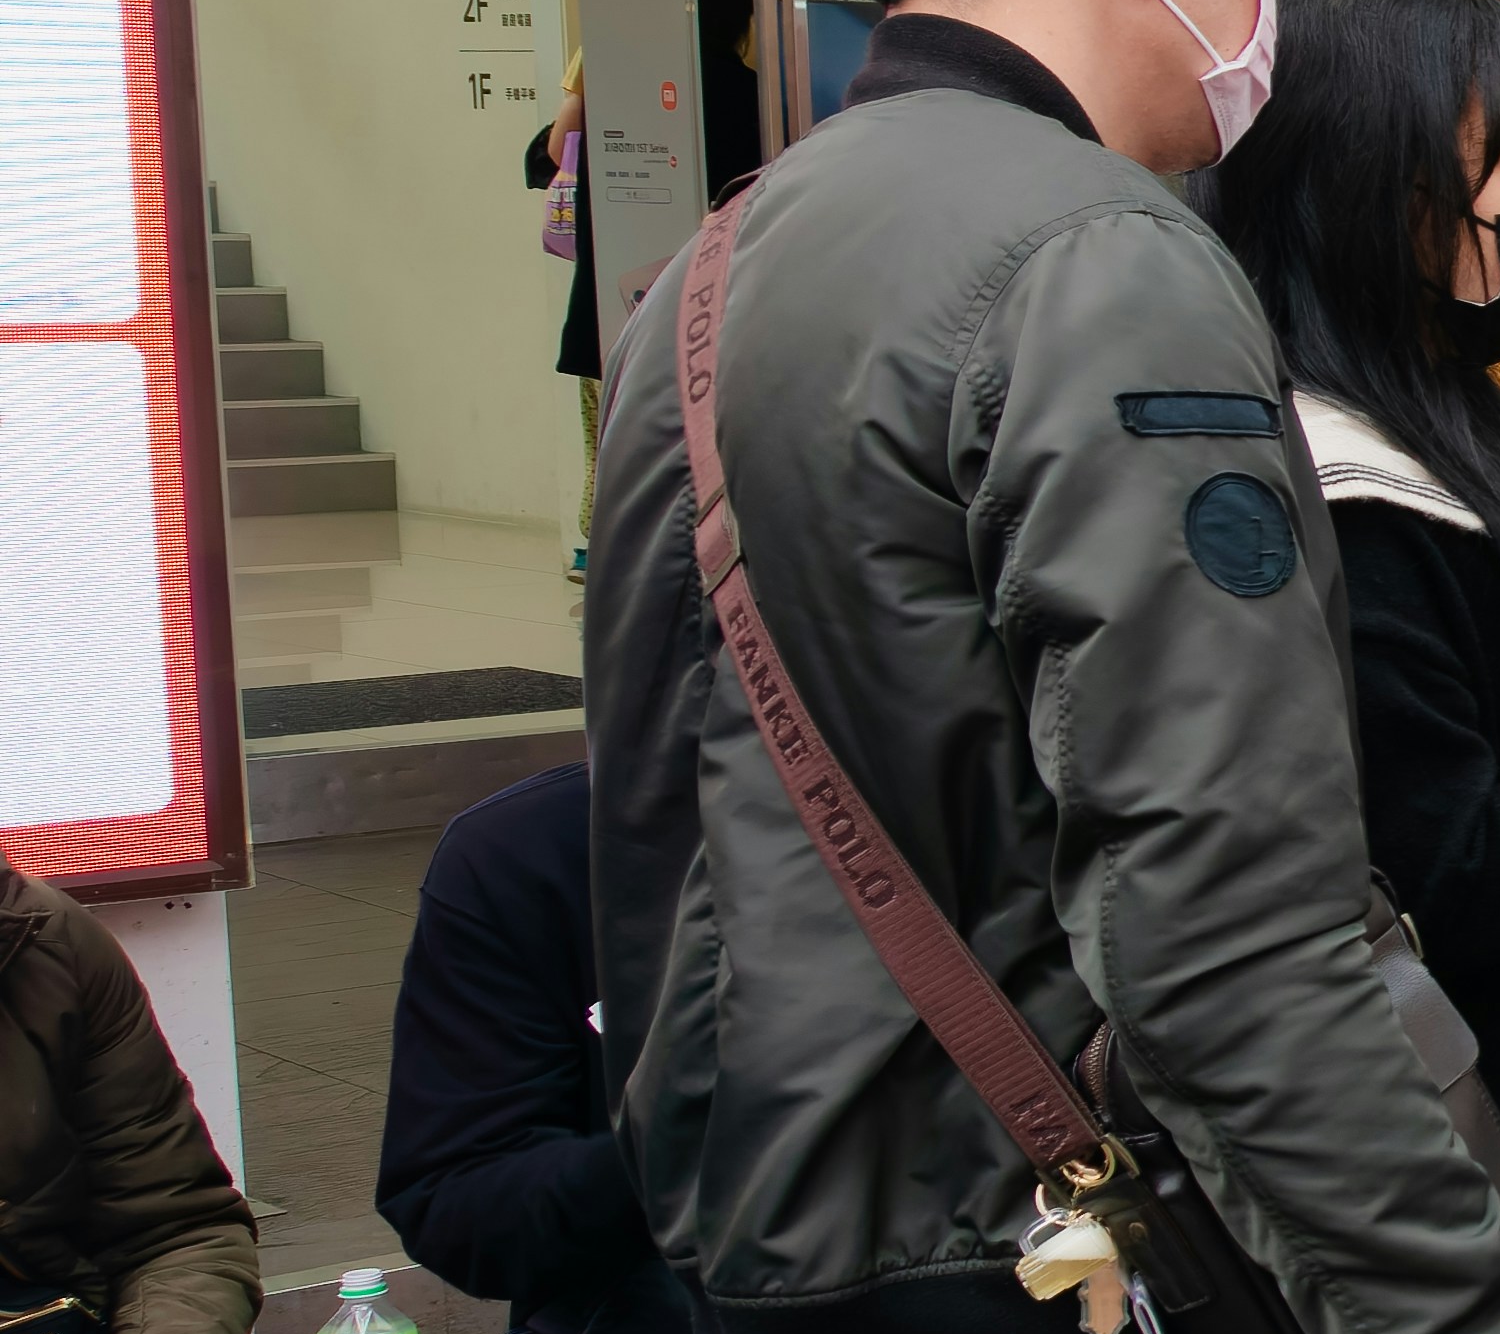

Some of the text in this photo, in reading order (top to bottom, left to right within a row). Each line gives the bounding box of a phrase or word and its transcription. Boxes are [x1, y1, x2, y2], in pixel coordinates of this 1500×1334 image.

[468, 73, 491, 109] 1F
[686, 279, 715, 406] POLO
[803, 780, 897, 912] POLO
